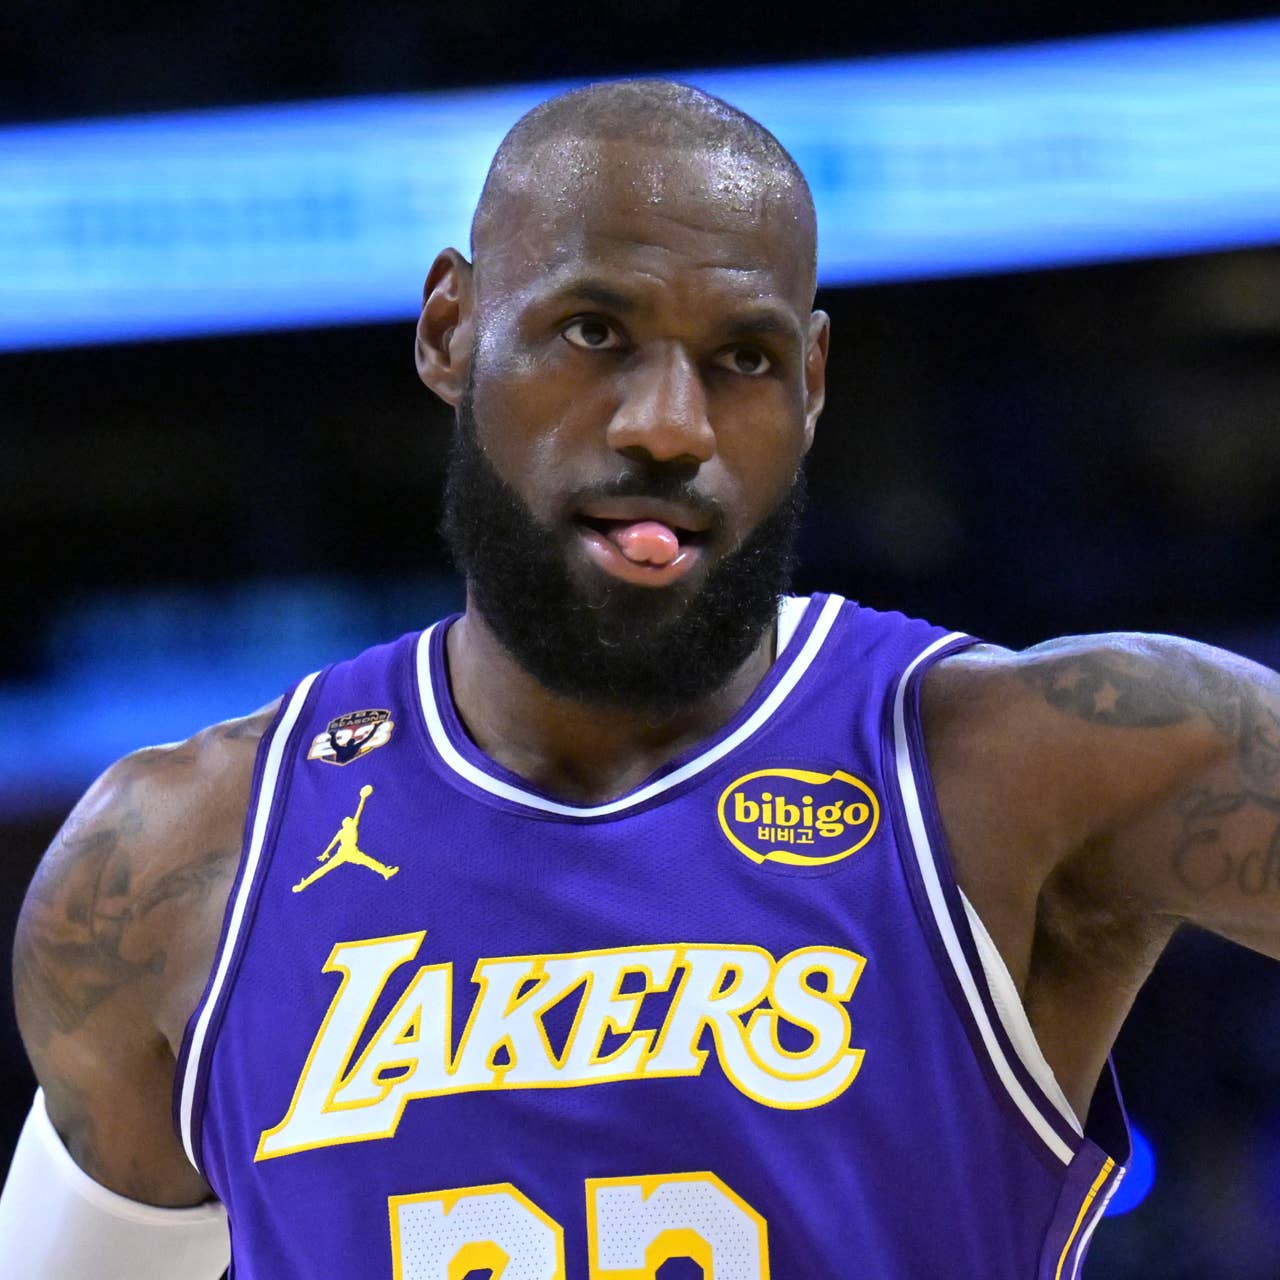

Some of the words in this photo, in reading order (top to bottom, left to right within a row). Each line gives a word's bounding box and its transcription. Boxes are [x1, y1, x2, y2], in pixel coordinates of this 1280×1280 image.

[734, 792, 870, 838] bibigo
[757, 826, 815, 844] 비비고
[254, 930, 868, 1162] LAKERS
